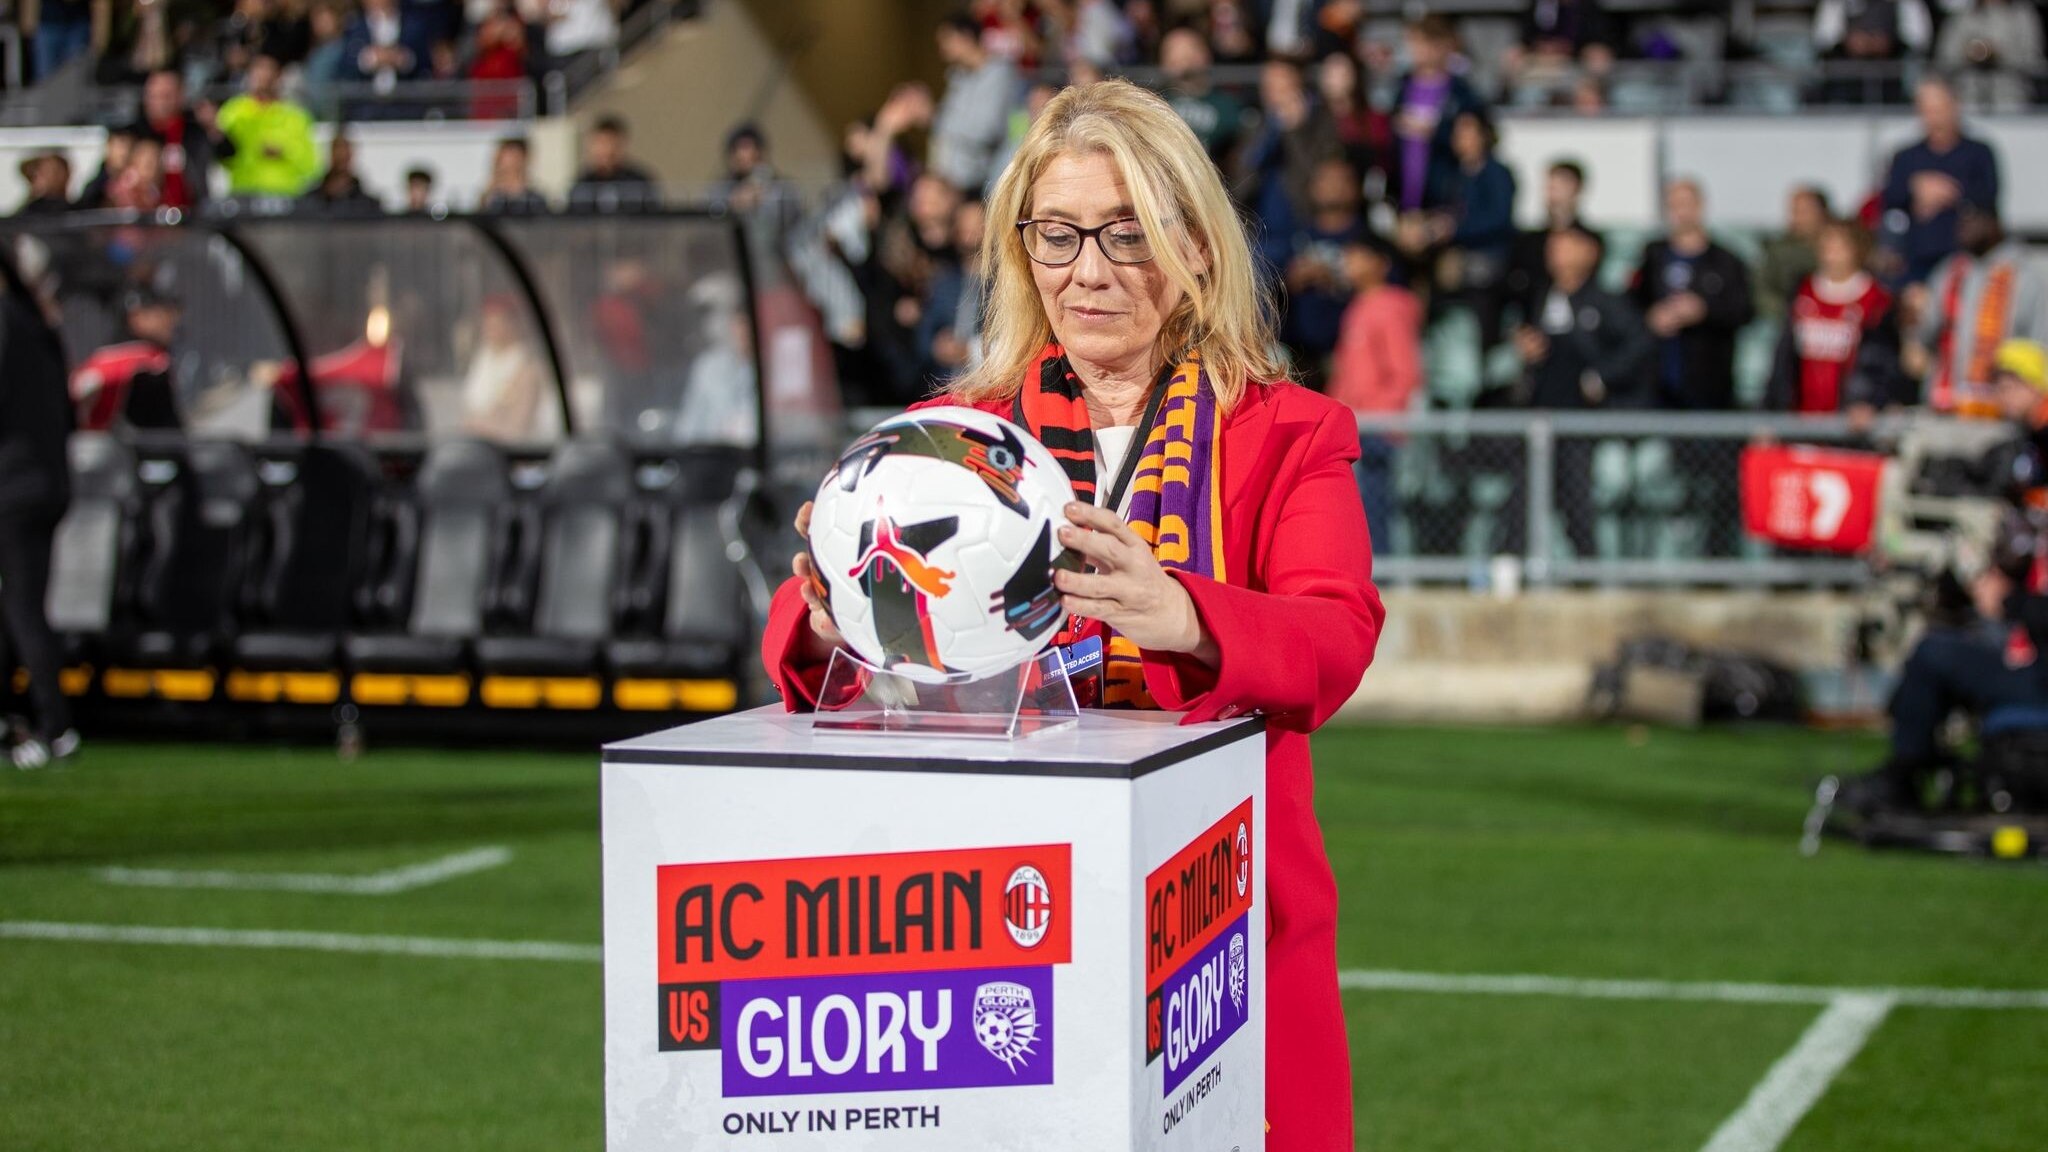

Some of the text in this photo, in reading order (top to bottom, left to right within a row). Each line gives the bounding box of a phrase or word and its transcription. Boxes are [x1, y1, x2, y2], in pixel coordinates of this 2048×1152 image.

[1043, 651, 1100, 681] RESTRCTED ACCESS
[1012, 869, 1042, 885] ACM
[675, 869, 982, 964] AC MILAN
[1150, 831, 1232, 974] AC MILAN
[1015, 930, 1040, 940] 1899
[981, 996, 1025, 1007] GLORY
[985, 986, 1024, 996] PERTH
[1167, 949, 1225, 1072] GLORY
[668, 990, 710, 1043] VS
[736, 989, 952, 1079] GLORY
[1163, 1061, 1221, 1135] ONLY IN PERTH
[722, 1105, 941, 1135] ONLY IN PERTH
